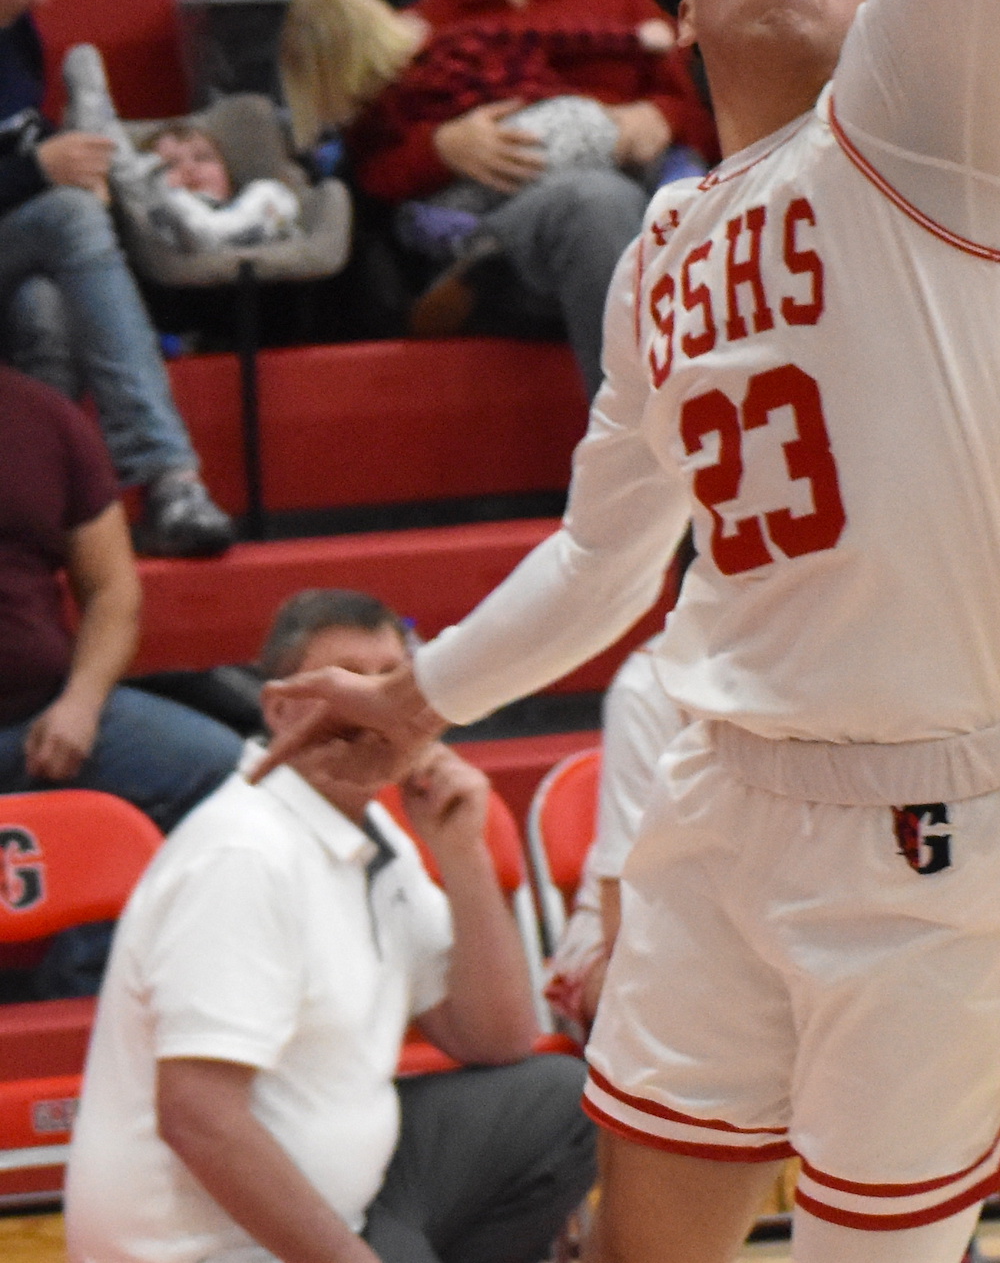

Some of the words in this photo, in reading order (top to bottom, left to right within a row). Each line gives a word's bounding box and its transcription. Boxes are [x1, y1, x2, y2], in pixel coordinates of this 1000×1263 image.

[680, 363, 847, 575] 23
[0, 825, 46, 912] G
[891, 802, 951, 874] G
